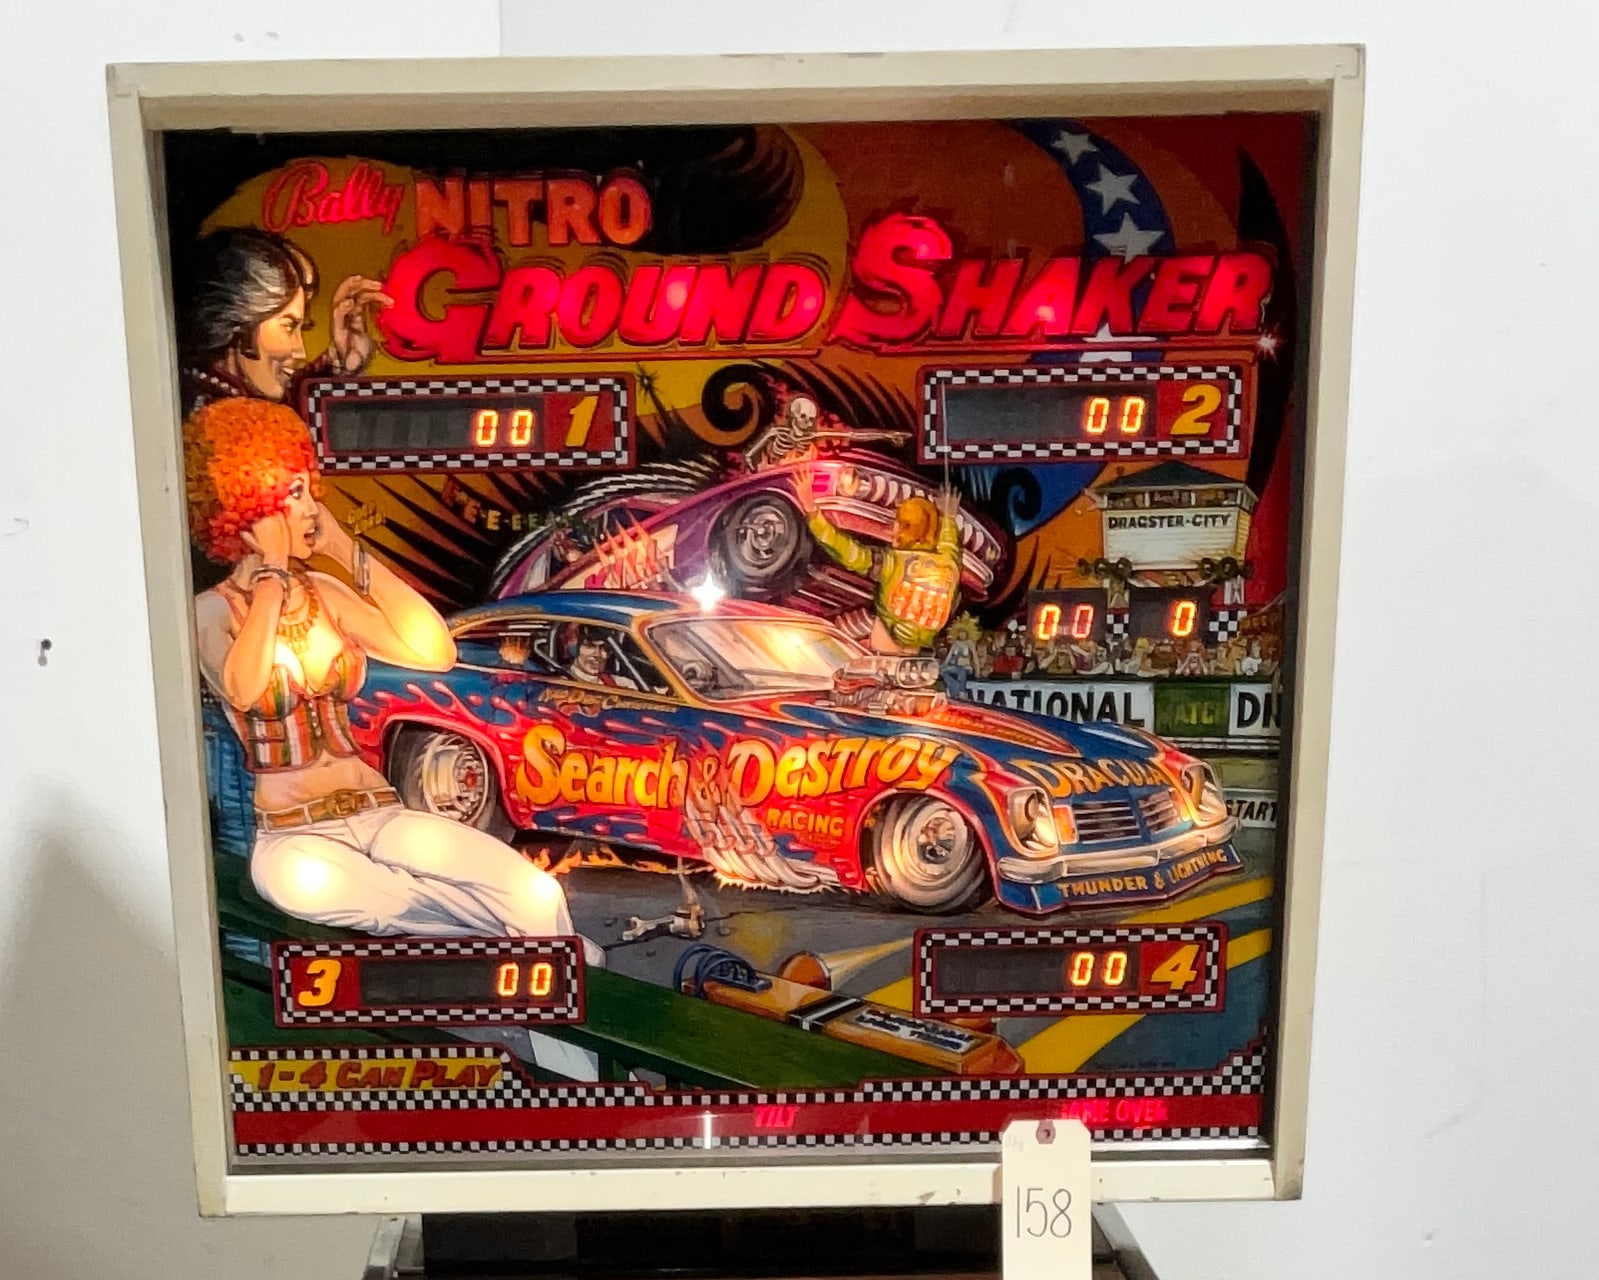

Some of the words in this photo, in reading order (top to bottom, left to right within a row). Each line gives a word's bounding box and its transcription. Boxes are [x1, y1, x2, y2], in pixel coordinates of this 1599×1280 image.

[262, 158, 405, 236] Bally
[414, 168, 653, 247] NITRO
[378, 235, 827, 364] GROUND
[832, 213, 1274, 347] SHAKER
[564, 395, 599, 448] 1
[1170, 384, 1222, 436] 2
[967, 689, 1146, 728] NATIONAL
[1010, 756, 1173, 798] DRACULA
[766, 808, 844, 837] RACING
[1058, 875, 1148, 898] THUNDER
[297, 958, 342, 1008] 3
[1151, 945, 1199, 990] 4
[755, 1106, 800, 1128] TILT
[1115, 1098, 1168, 1123] OVER
[1016, 1185, 1072, 1239] 158
